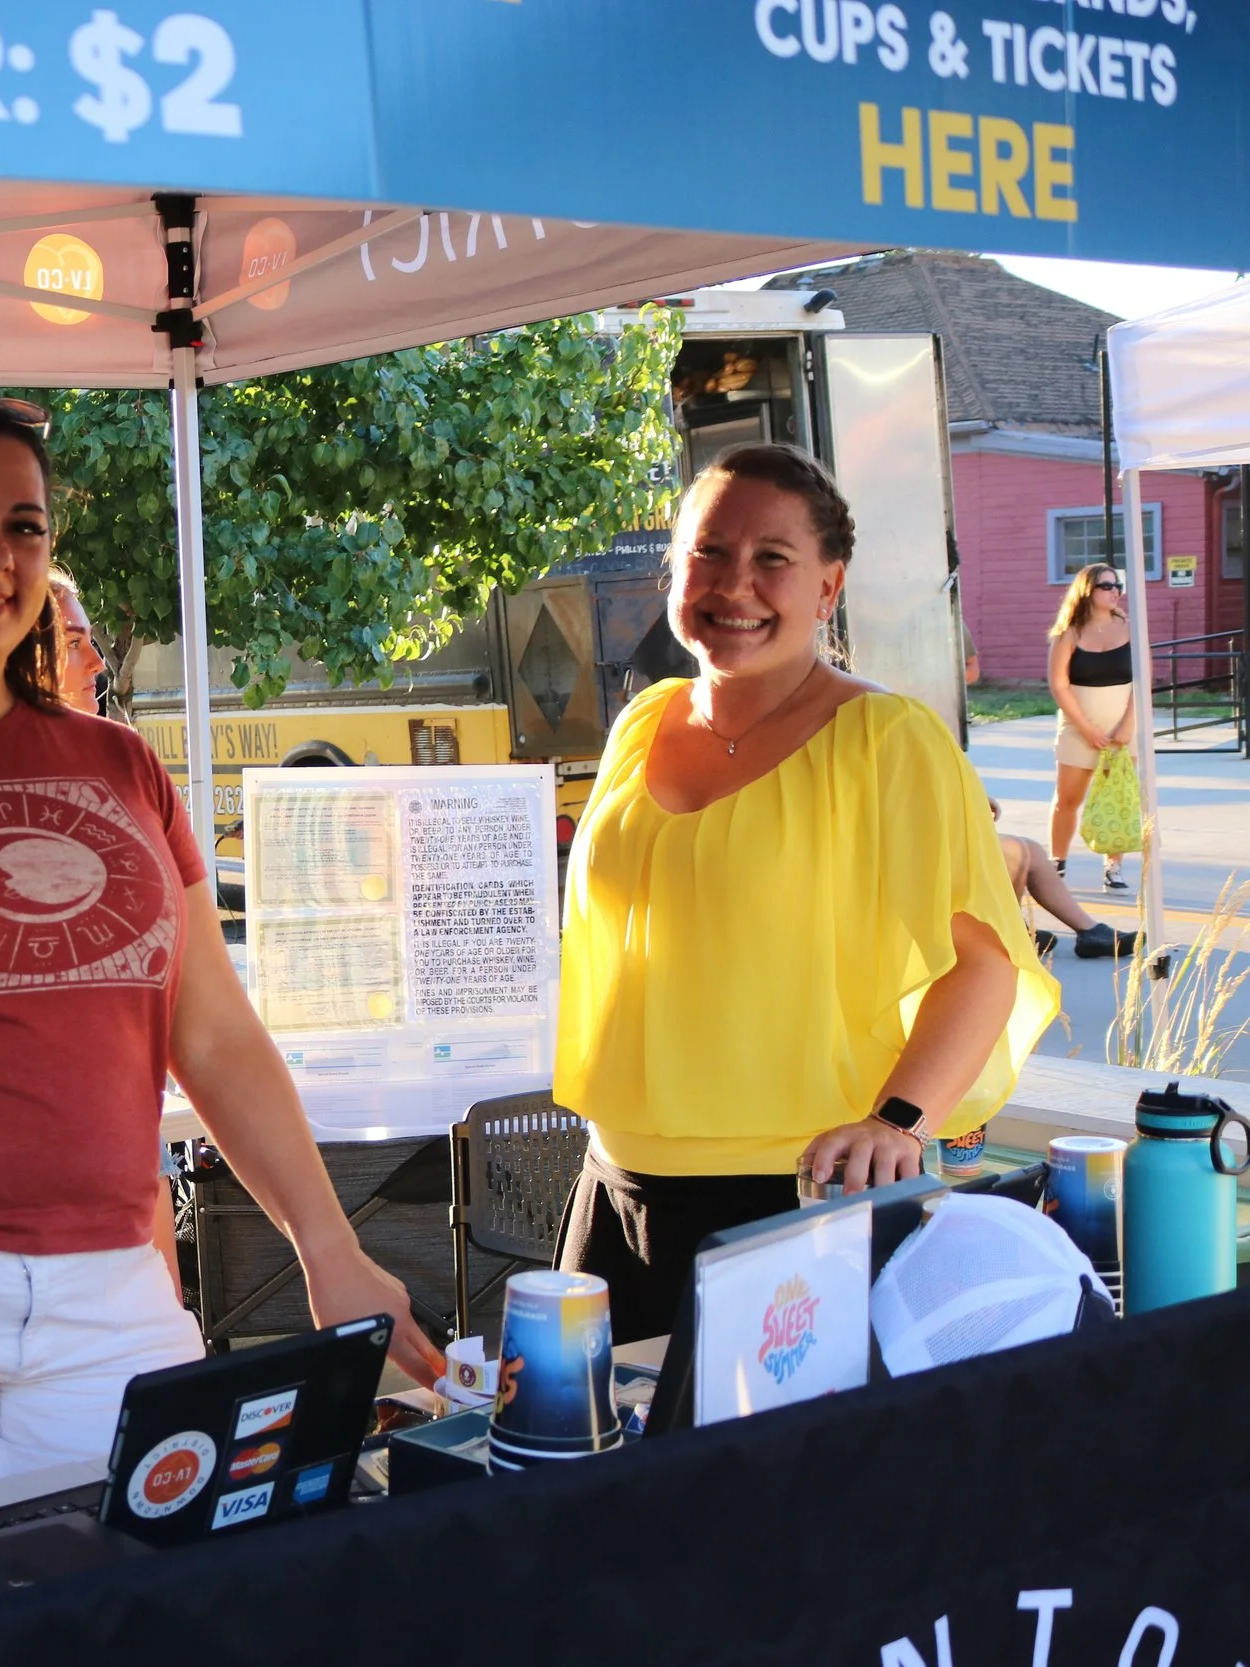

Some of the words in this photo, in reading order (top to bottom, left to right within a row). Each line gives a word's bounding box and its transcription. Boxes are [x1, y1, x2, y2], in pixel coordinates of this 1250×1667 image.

[754, 0, 910, 73] CUPS
[928, 11, 970, 79] &
[982, 18, 1178, 107] TICKETS
[68, 8, 243, 143] $2
[859, 101, 1078, 223] HERE
[238, 723, 279, 758] WAY!
[431, 798, 478, 810] WARNING
[412, 882, 474, 892] IDENTIFICATION
[479, 881, 503, 889] CARDS
[509, 880, 533, 888] WHICH
[421, 928, 437, 936] LAW
[440, 927, 493, 935] ENFORCEMENT
[454, 918, 468, 926] AND
[456, 987, 507, 995] IMPRISONMENT
[427, 1007, 449, 1015] THESE
[775, 1272, 810, 1309] ONE
[758, 1297, 820, 1363] SWEET
[764, 1330, 817, 1385] SUMMER
[230, 1448, 280, 1473] MasterCard
[222, 1491, 268, 1518] VISA
